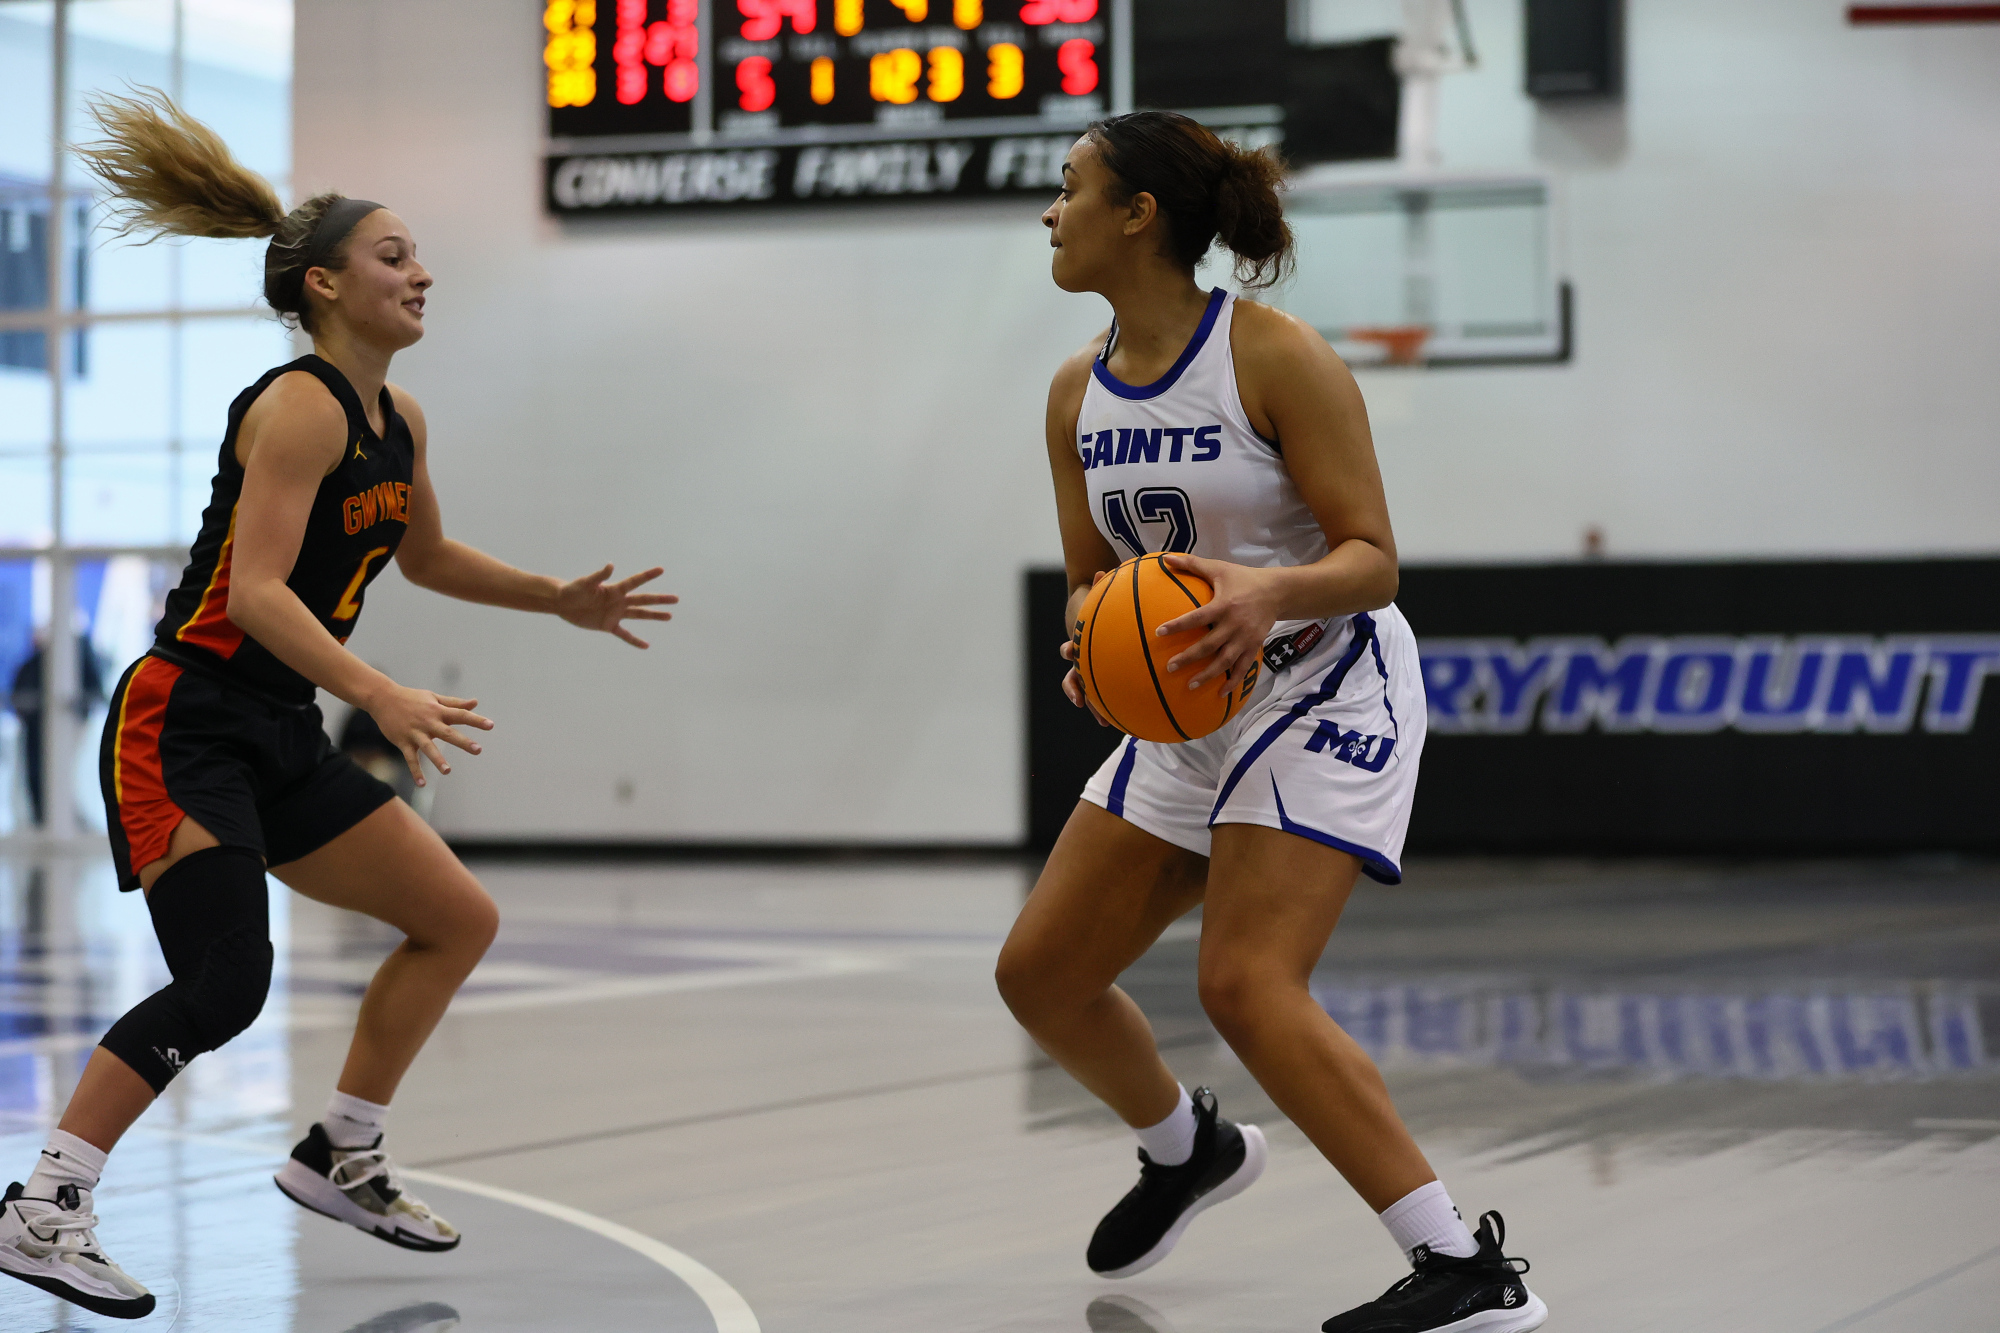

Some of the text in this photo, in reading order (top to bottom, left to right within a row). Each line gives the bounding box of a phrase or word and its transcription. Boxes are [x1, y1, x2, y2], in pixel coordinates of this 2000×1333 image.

[553, 150, 777, 208] CONVERSE
[794, 140, 974, 198] FAMILY
[1297, 626, 1320, 650] AUTHENTIC
